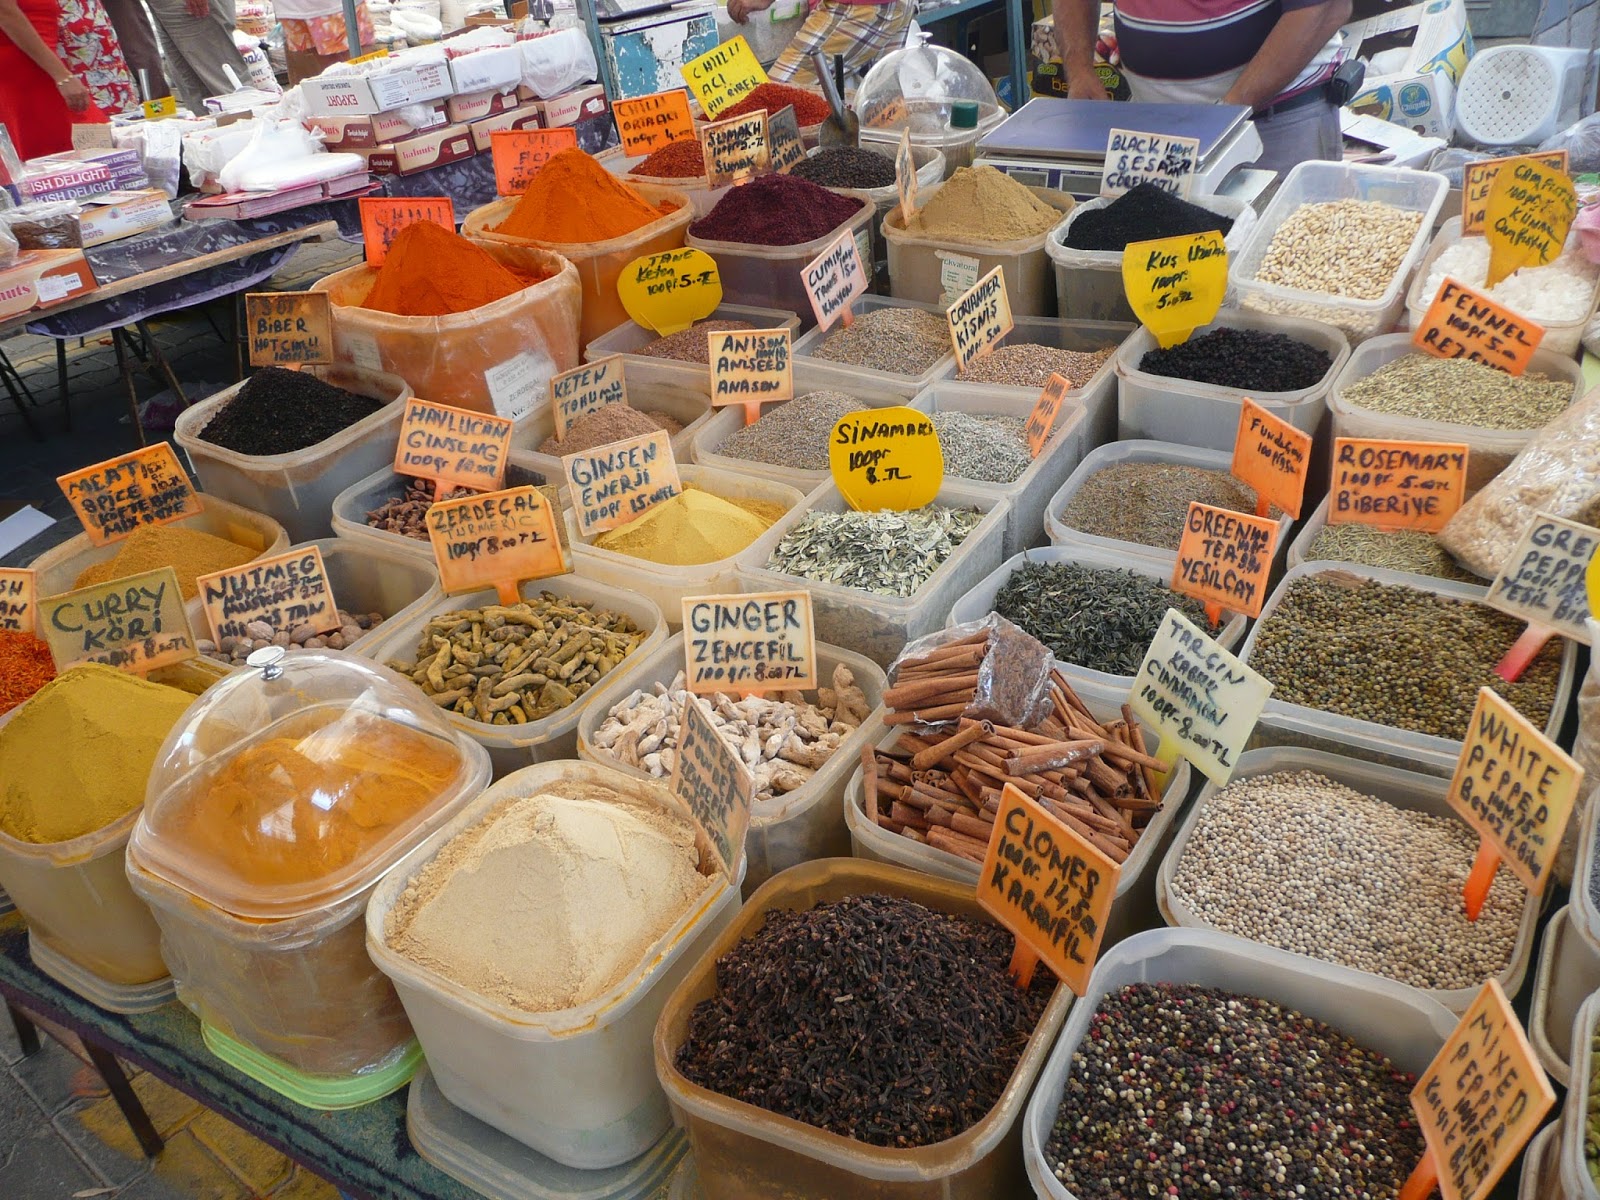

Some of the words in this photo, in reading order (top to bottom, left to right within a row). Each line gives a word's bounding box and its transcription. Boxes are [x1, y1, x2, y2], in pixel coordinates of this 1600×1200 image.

[326, 94, 359, 107] EXPORT
[1110, 135, 1160, 156] BLACK
[55, 168, 107, 188] DELIGHT
[68, 180, 118, 201] DELIGHT
[808, 245, 842, 288] CUMIN
[0, 283, 31, 300] nuts
[950, 274, 1001, 327] CORIANDER
[1440, 283, 1532, 347] FENNEL
[554, 365, 607, 399] KETEN
[716, 378, 780, 395] ANASON
[407, 430, 500, 462] GINSENG
[1338, 444, 1465, 471] ROSEMARY
[571, 442, 657, 488] GINSEN
[1188, 505, 1252, 541] GREEN
[1202, 539, 1238, 563] TEA
[205, 555, 316, 605] NUTMEG
[51, 581, 166, 633] CURRY
[691, 599, 801, 634] GINGER
[692, 632, 805, 665] ZENCEFİL
[784, 665, 808, 680] TL
[1479, 710, 1560, 797] WHITE
[1450, 1041, 1505, 1148] PEPPER
